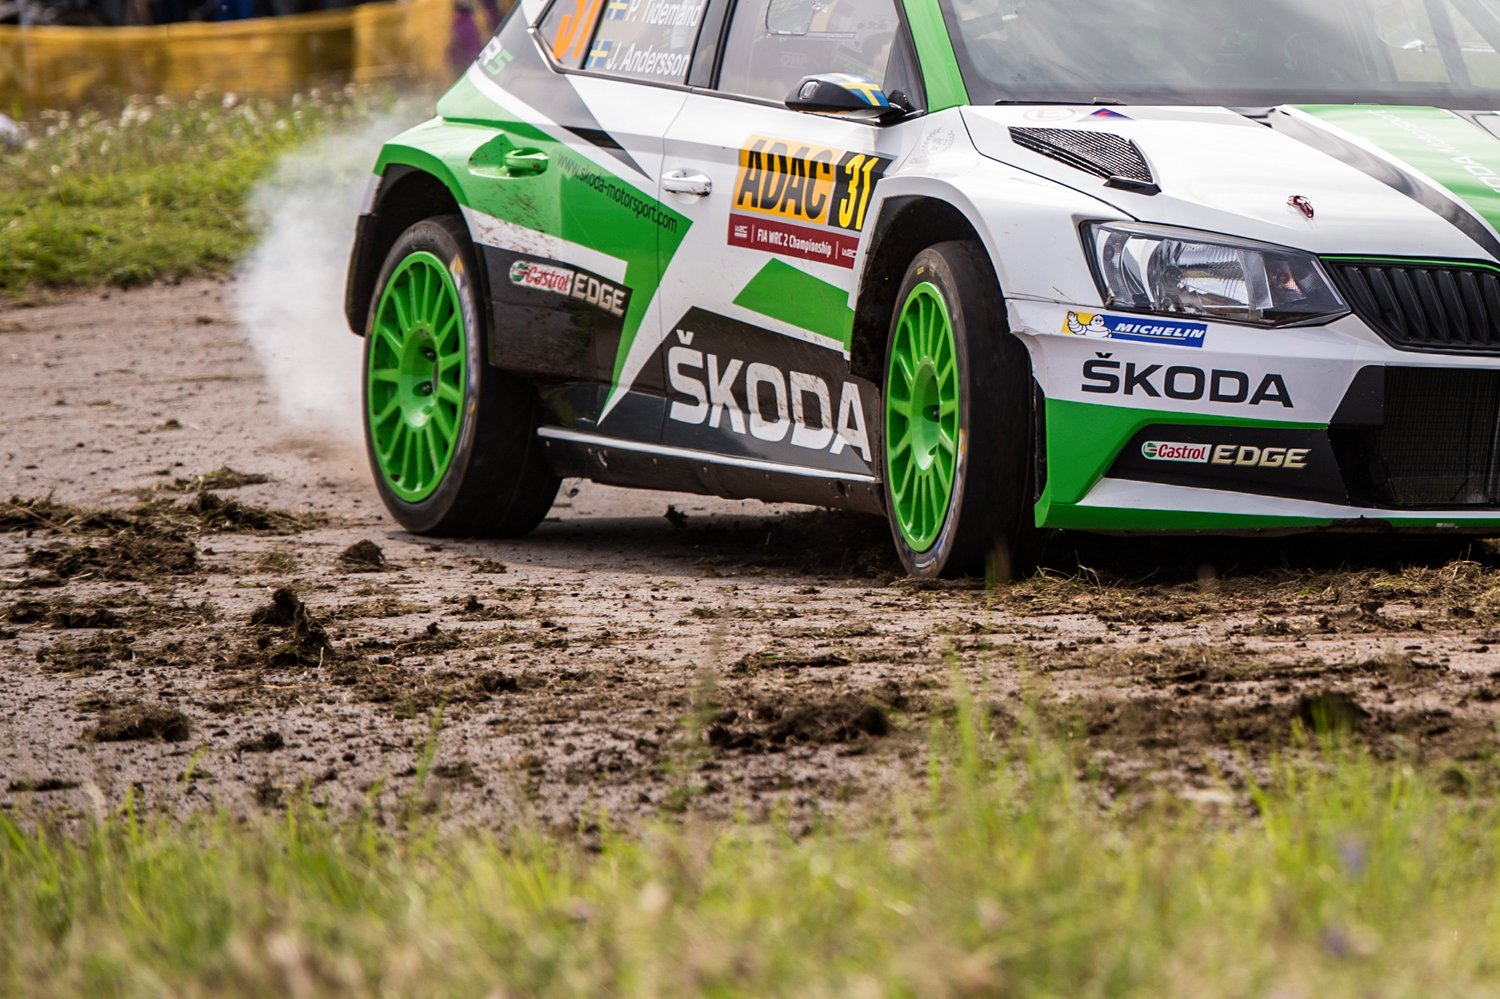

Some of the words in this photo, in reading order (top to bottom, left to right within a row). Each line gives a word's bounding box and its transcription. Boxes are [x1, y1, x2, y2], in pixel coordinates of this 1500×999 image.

[478, 35, 514, 75] R5
[606, 41, 622, 70] J.
[618, 42, 690, 77] Andersson
[557, 152, 678, 234] www.skoda-motorsport.com
[737, 139, 833, 220] ADAC
[838, 154, 879, 231] 31
[757, 228, 768, 242] FIA
[768, 230, 783, 246] WRC
[783, 233, 789, 247] 2
[789, 234, 832, 258] Championship
[525, 266, 570, 291] Castrol
[571, 273, 627, 318] EDGE
[1114, 322, 1205, 339] MICHELIN
[668, 329, 872, 462] ŠKODA
[1081, 352, 1294, 408] ŠKODA
[1157, 443, 1206, 460] Castrol
[1210, 444, 1312, 469] EDGE
